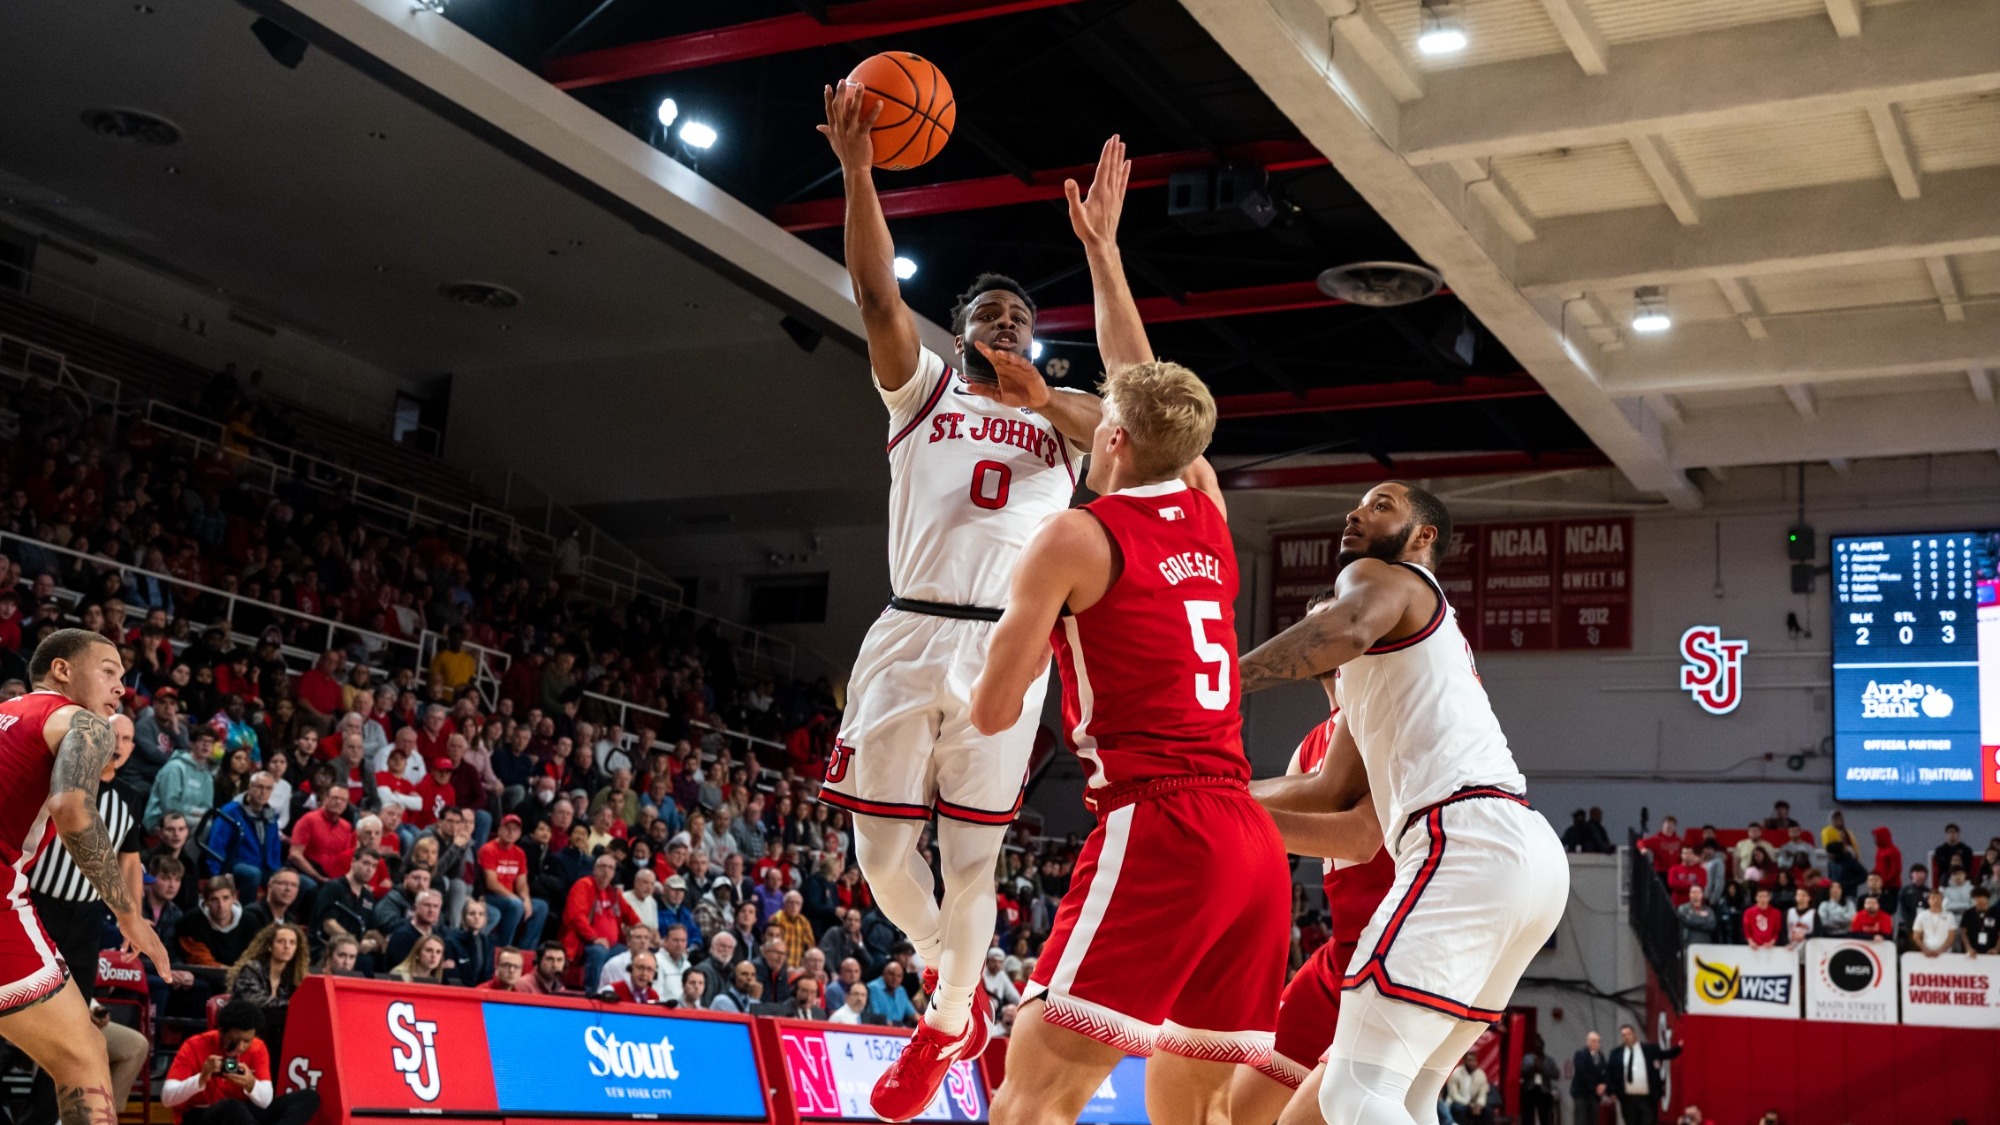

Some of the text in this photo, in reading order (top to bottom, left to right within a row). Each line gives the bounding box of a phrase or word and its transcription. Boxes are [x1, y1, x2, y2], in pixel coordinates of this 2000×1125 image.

[929, 413, 1057, 468] ST. JOHN'S
[970, 460, 1012, 510] 0
[1490, 529, 1549, 557] NCAA
[1565, 525, 1624, 554] NCAA
[1850, 542, 1884, 551] PLAYER
[1281, 539, 1332, 567] WNIT
[1159, 552, 1223, 585] GRIESEL
[1487, 576, 1550, 589] APPEARANCES
[1562, 570, 1626, 589] SWEET 16
[1579, 608, 1610, 625] 2012
[1850, 610, 1957, 624] BLK STL TO
[1856, 625, 1956, 645] 2 0 3
[1183, 600, 1231, 711] 5
[1861, 680, 1925, 702] Apple
[1861, 699, 1920, 718] Bank
[1863, 739, 1952, 750] OFFICIAL PARTNER
[1918, 768, 1974, 781] TRATTORIA
[1845, 965, 1870, 976] MSR
[1740, 976, 1788, 1003] WISE
[1909, 973, 1990, 989] JOHNNIES
[1847, 1002, 1886, 1012] STREET
[1909, 990, 1991, 1007] WORK HERE.
[584, 1026, 680, 1080] Stout
[845, 1042, 854, 1061] 4
[864, 1039, 901, 1062] 15:28
[782, 1034, 839, 1113] N
[605, 1086, 672, 1100] NEW YORK CITY
